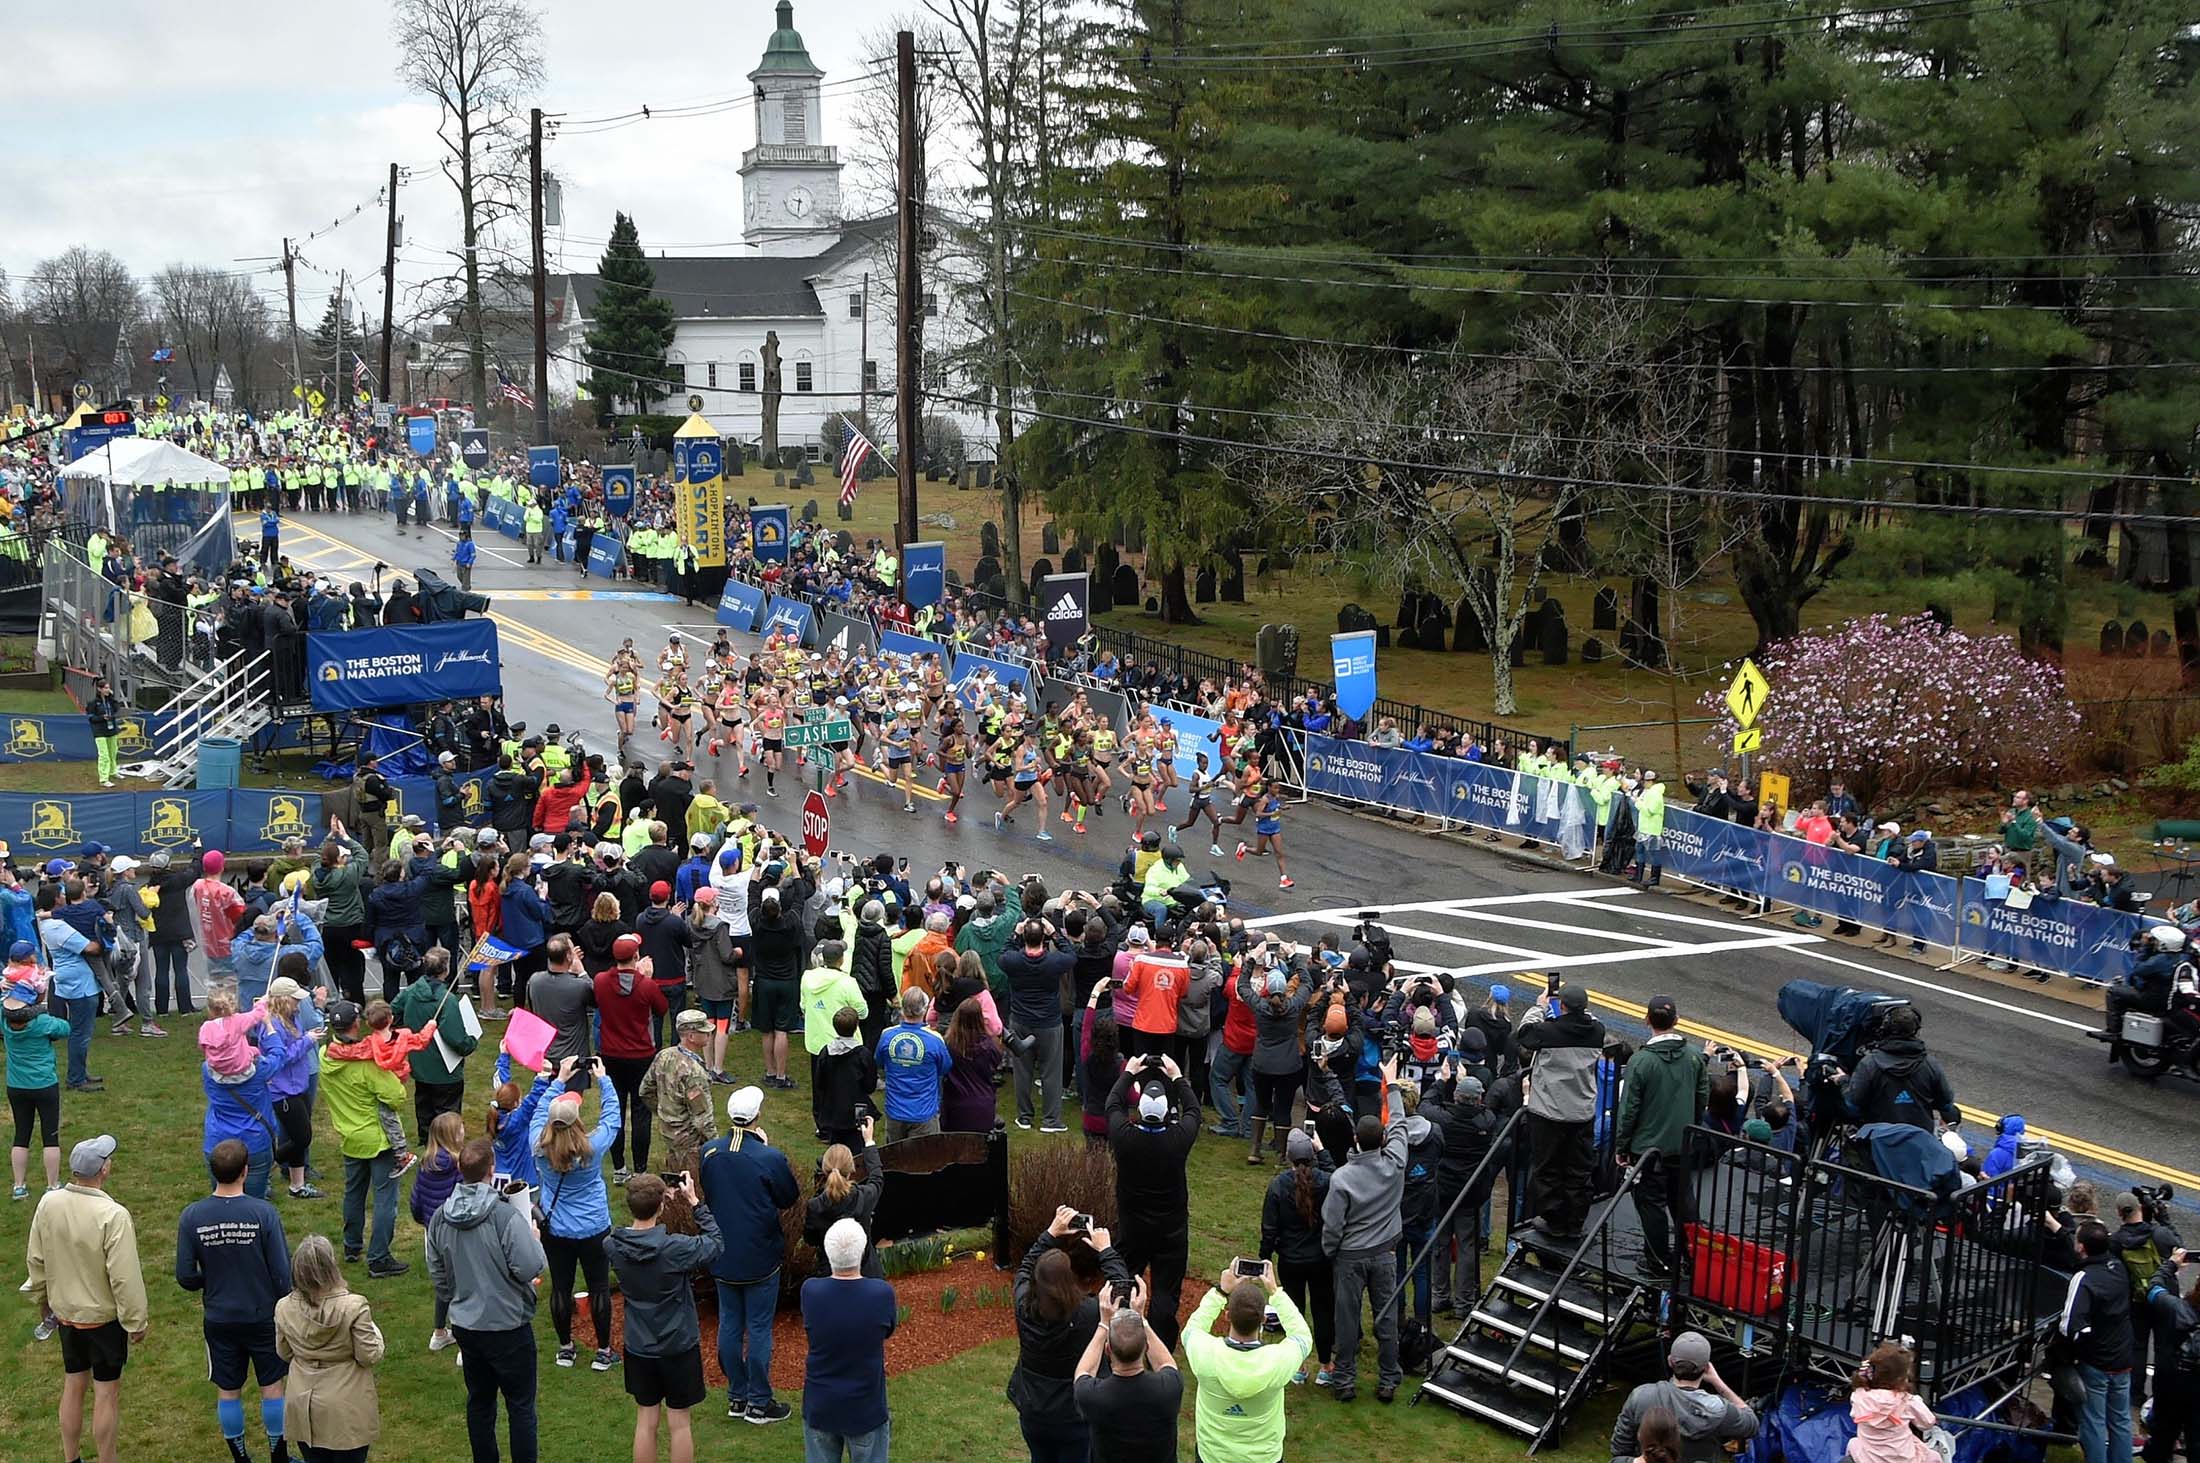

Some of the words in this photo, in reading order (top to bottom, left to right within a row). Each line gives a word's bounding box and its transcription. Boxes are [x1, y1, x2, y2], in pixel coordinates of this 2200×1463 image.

[376, 415, 388, 424] 85
[693, 486, 709, 558] START
[709, 489, 720, 551] HOPKINTON
[1047, 609, 1083, 620] adidas
[346, 659, 369, 670] THE
[372, 653, 421, 667] BOSTON
[434, 651, 457, 673] John
[455, 649, 492, 665] Hancock
[347, 664, 422, 680] MARATHON
[803, 725, 828, 743] ASH
[838, 725, 848, 736] ST
[1327, 755, 1346, 767] THE
[1346, 758, 1382, 773] BOSTON
[1327, 765, 1381, 783] MARATHON
[1472, 784, 1490, 796] THE
[1491, 787, 1529, 804] BOSON
[803, 810, 828, 842] STOP
[1662, 840, 1703, 857] ATHON
[1809, 866, 1832, 881] THE
[1834, 870, 1883, 893] BOSTON
[1807, 877, 1883, 904] MARATHON
[1992, 907, 2019, 923] THE
[2021, 913, 2076, 936] BOSTON
[1991, 919, 2077, 948] MARATHON
[479, 942, 513, 961] BOSTON
[221, 1230, 256, 1238] Leaders
